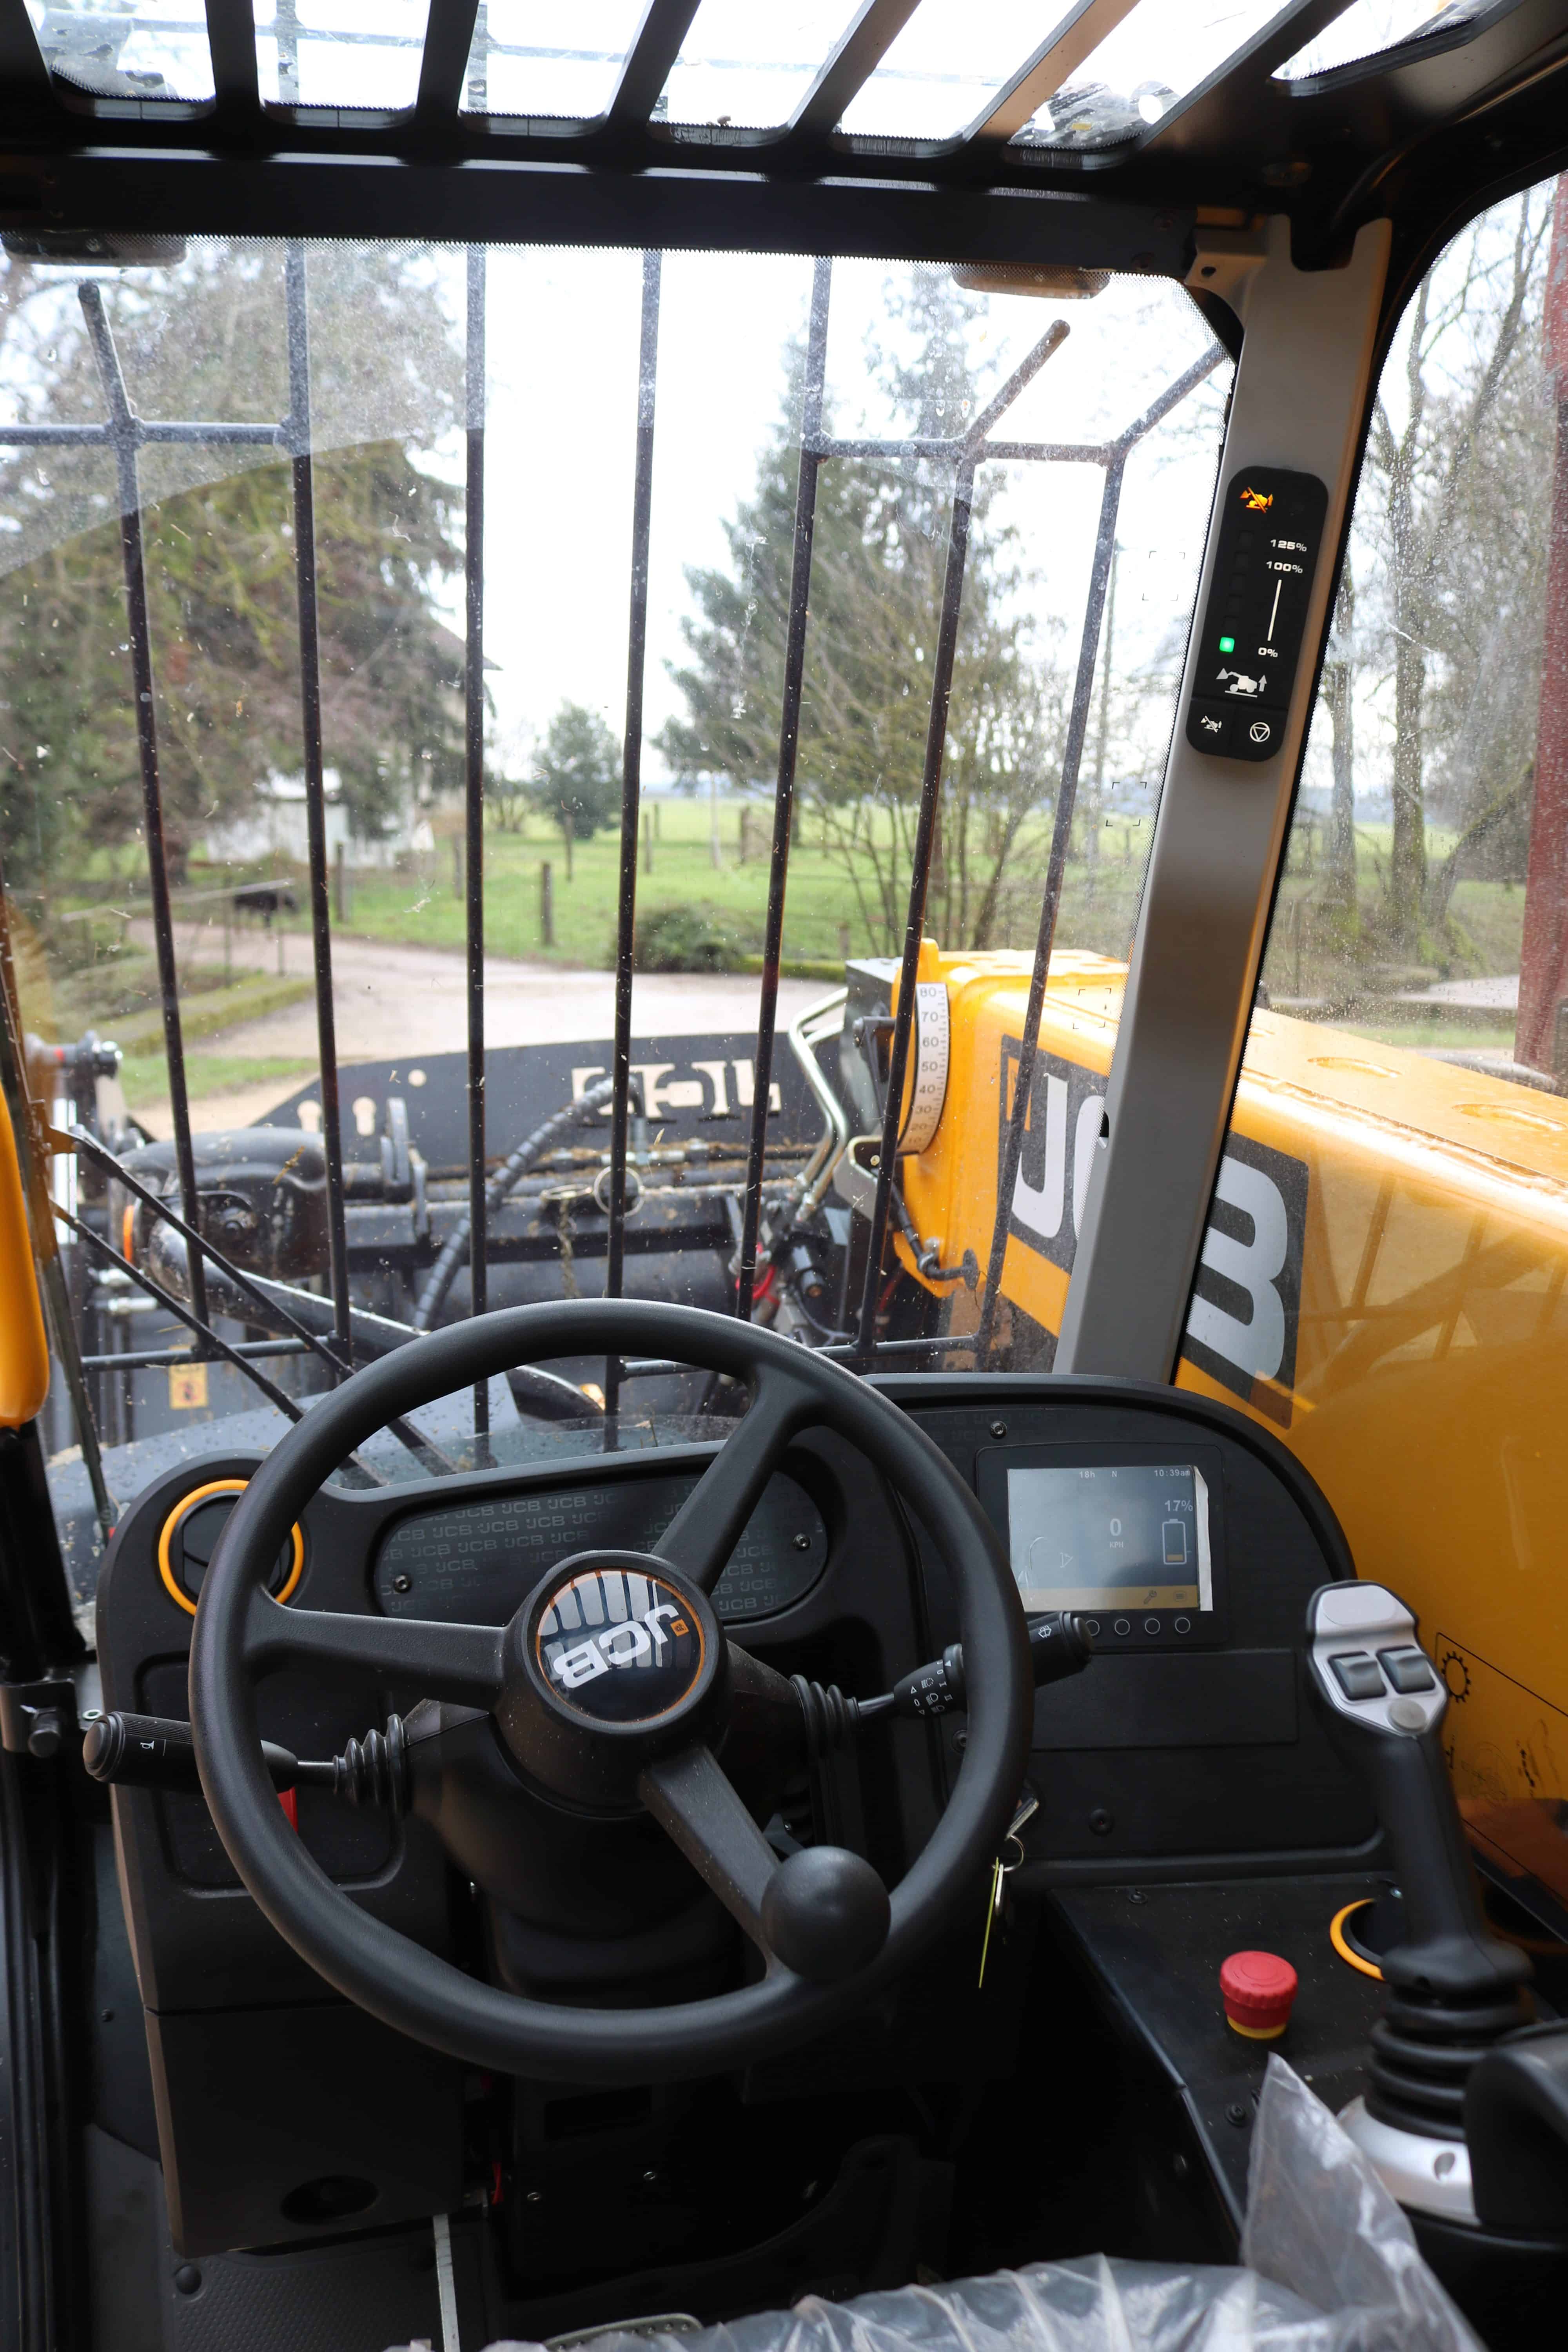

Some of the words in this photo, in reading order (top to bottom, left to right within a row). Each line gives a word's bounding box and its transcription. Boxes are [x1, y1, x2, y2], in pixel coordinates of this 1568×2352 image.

[1270, 539, 1307, 552] 125%
[1266, 561, 1303, 573] 100%
[1258, 647, 1278, 657] 0%
[920, 987, 937, 998] 80
[922, 1011, 938, 1022] 70
[922, 1037, 939, 1047] 60
[921, 1061, 938, 1072] 50
[919, 1084, 936, 1094] 40
[915, 1105, 932, 1114] 30
[1079, 1470, 1095, 1478] 18h
[501, 1500, 541, 1515] JCB
[548, 1495, 587, 1510] JCB
[1164, 1499, 1193, 1512] 17%
[432, 1524, 473, 1539] JCB
[478, 1519, 519, 1534] JCB
[526, 1515, 566, 1529] JCB
[1110, 1518, 1122, 1537] 0
[410, 1543, 451, 1558] JCB
[457, 1539, 498, 1553] JCB
[504, 1534, 544, 1548] JCB
[436, 1559, 475, 1573] JCB
[719, 1597, 757, 1612] JCB
[553, 1604, 679, 1688] JCB
